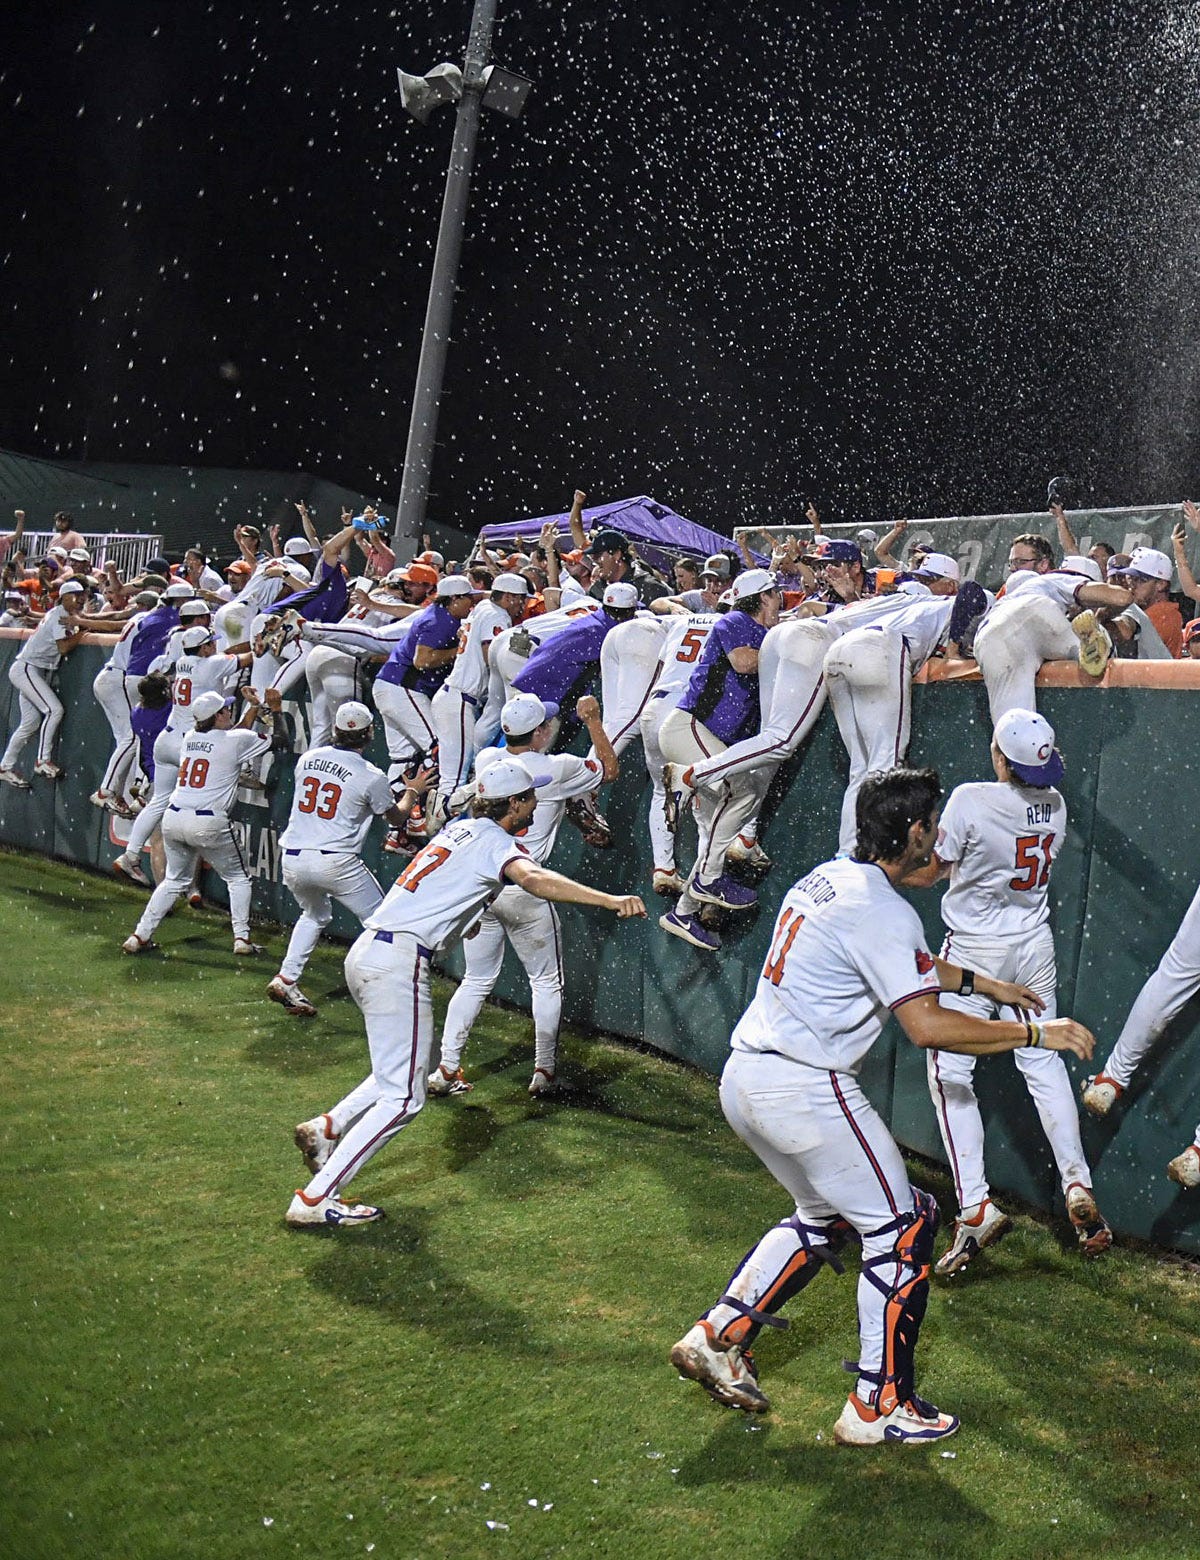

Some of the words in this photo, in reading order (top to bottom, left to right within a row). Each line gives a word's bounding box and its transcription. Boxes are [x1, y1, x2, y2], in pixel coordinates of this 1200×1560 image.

[676, 628, 708, 663] 5
[186, 741, 214, 754] HUGHES
[178, 756, 210, 789] 48
[297, 775, 343, 821] 33
[1026, 803, 1051, 826] REID
[798, 872, 836, 907] BERTOP
[763, 906, 806, 987] 11
